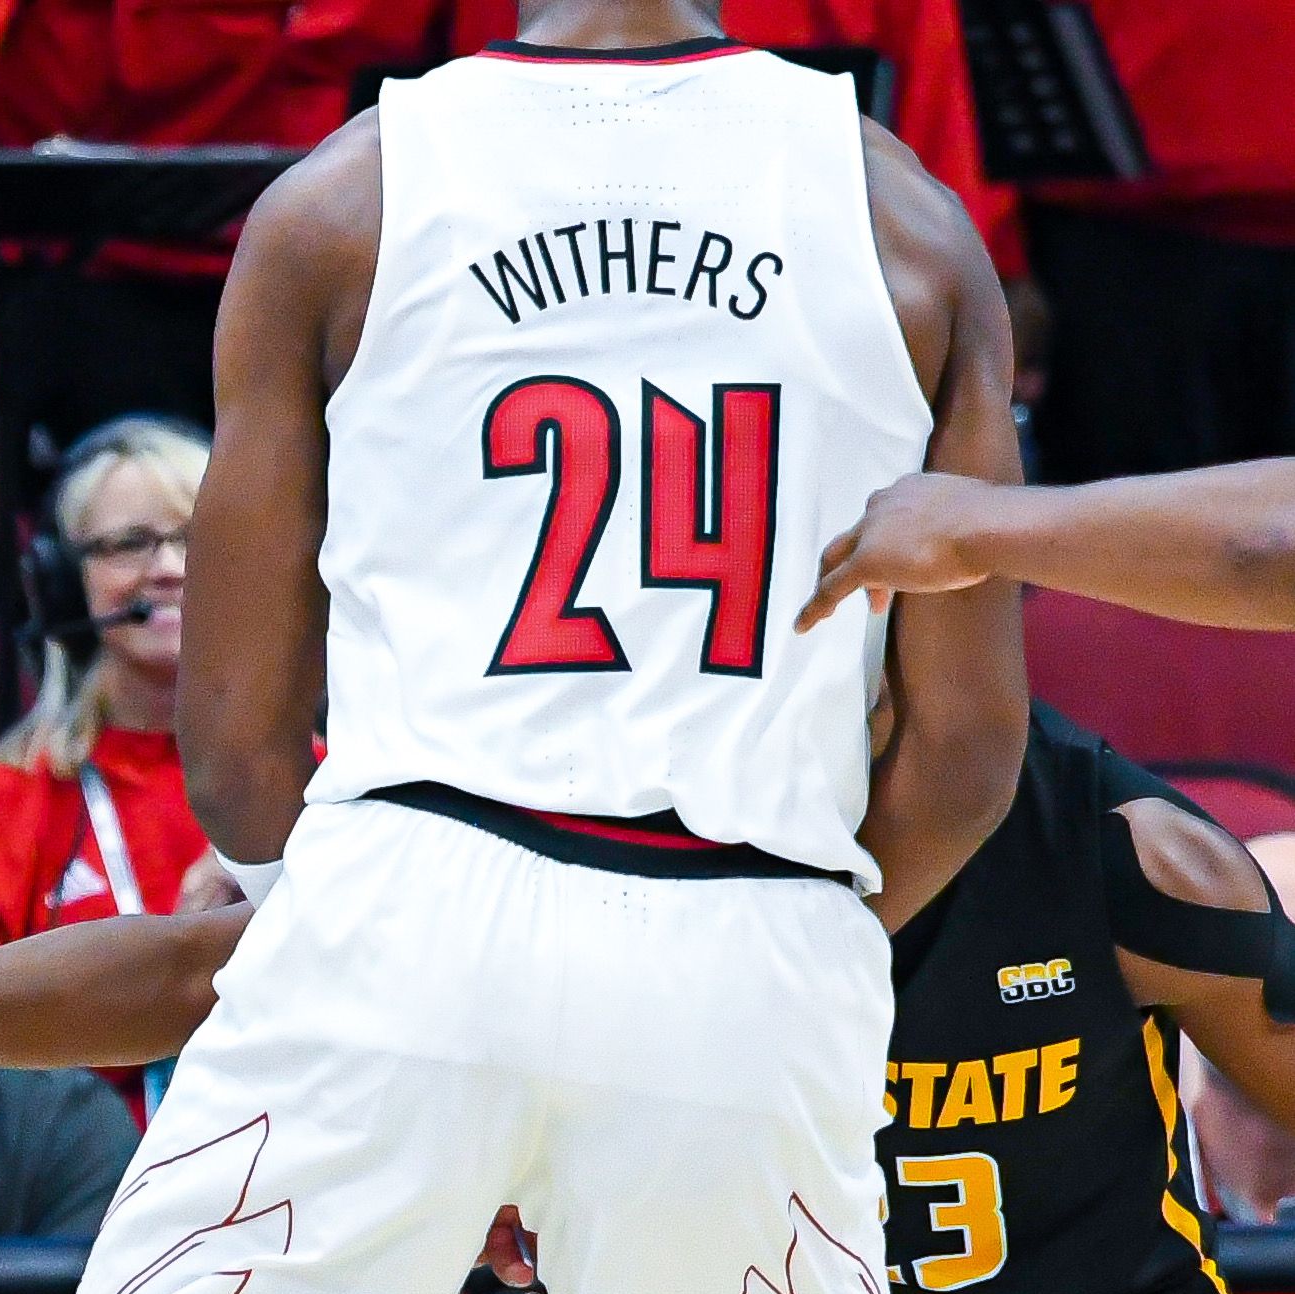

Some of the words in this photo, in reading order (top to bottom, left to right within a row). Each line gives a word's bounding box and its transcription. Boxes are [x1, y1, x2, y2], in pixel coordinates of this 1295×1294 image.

[469, 218, 784, 324] WITHERS
[481, 374, 782, 679] 24
[997, 958, 1076, 1004] SBC
[878, 1151, 1009, 1293] 3
